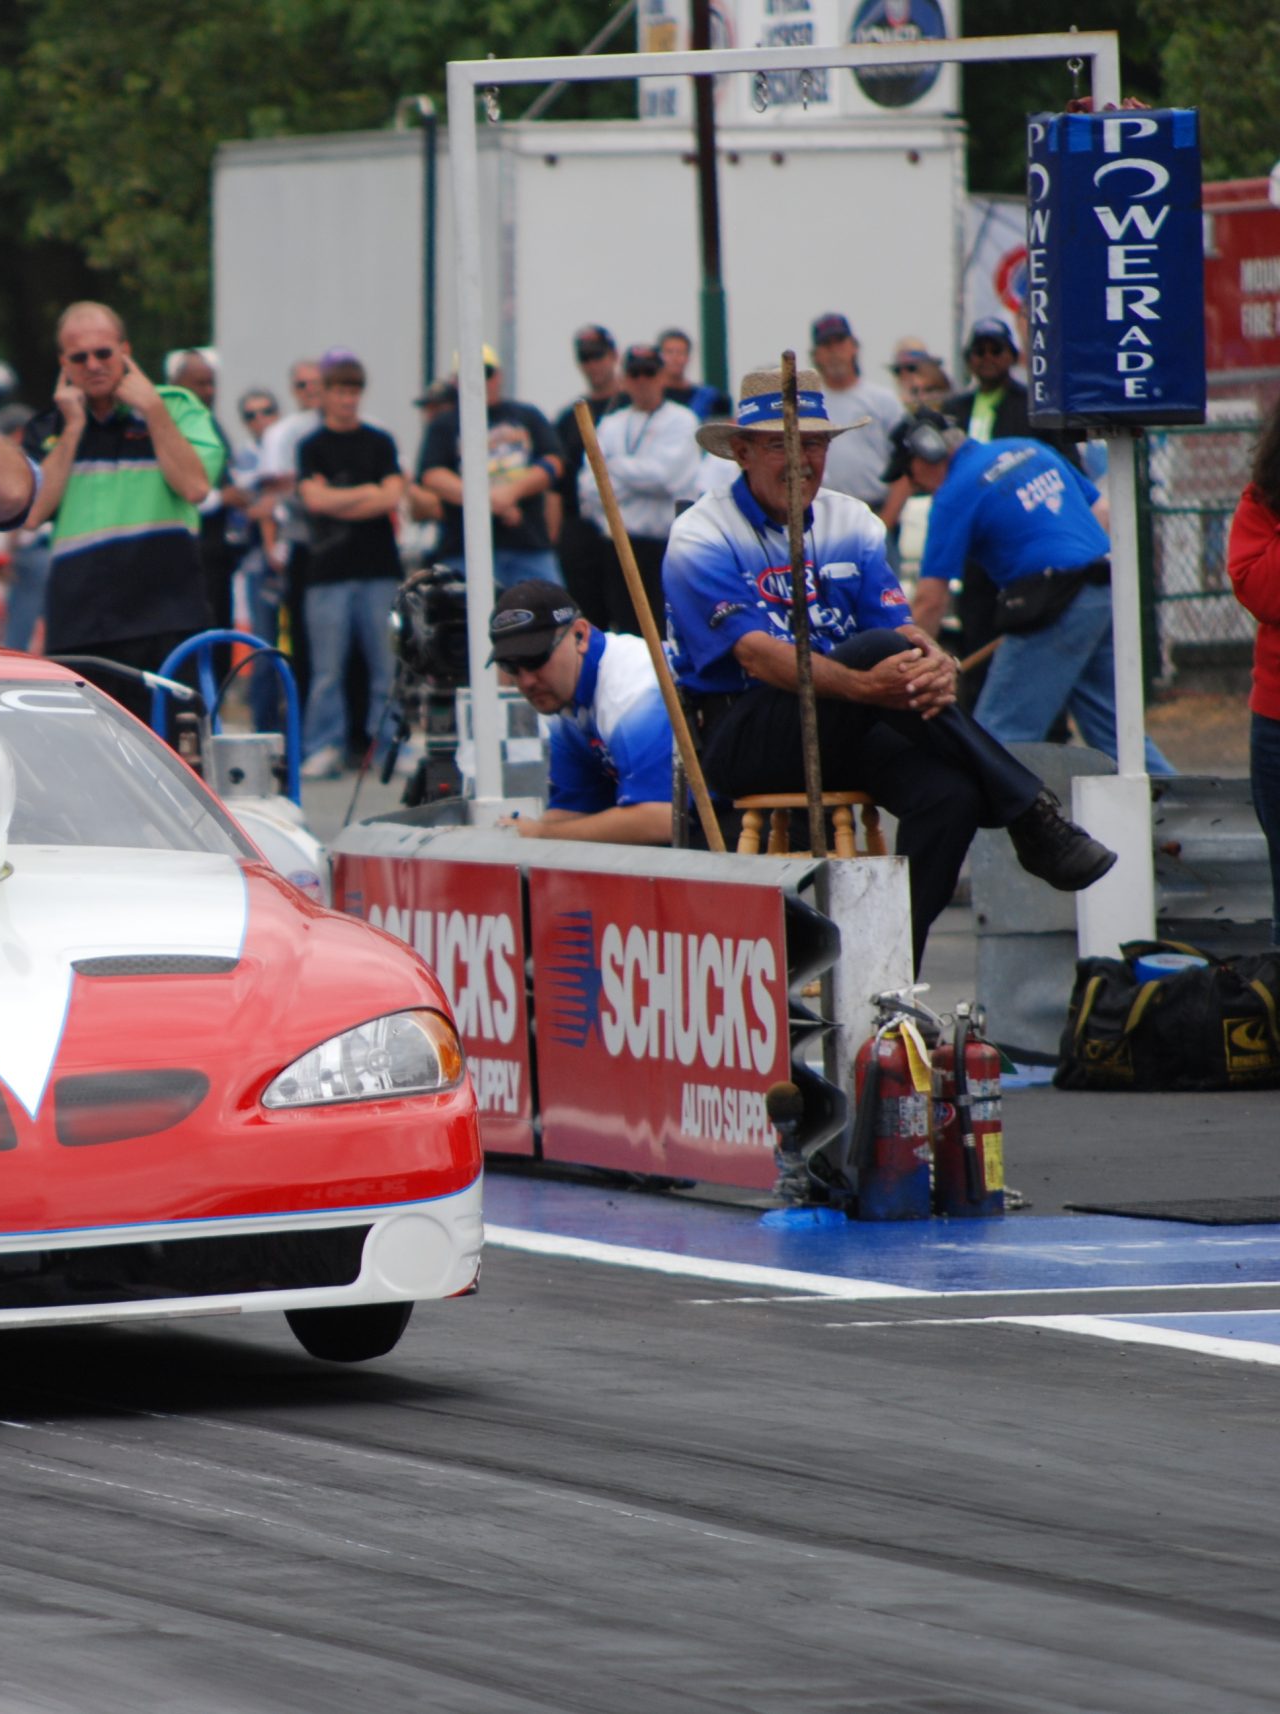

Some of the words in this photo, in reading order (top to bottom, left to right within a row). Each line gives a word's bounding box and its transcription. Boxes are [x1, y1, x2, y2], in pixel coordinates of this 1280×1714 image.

[1094, 118, 1170, 398] POWERADE
[601, 923, 777, 1076] SCHUCK'S
[680, 1082, 721, 1142] AUTO
[723, 1087, 778, 1148] SUPPL
